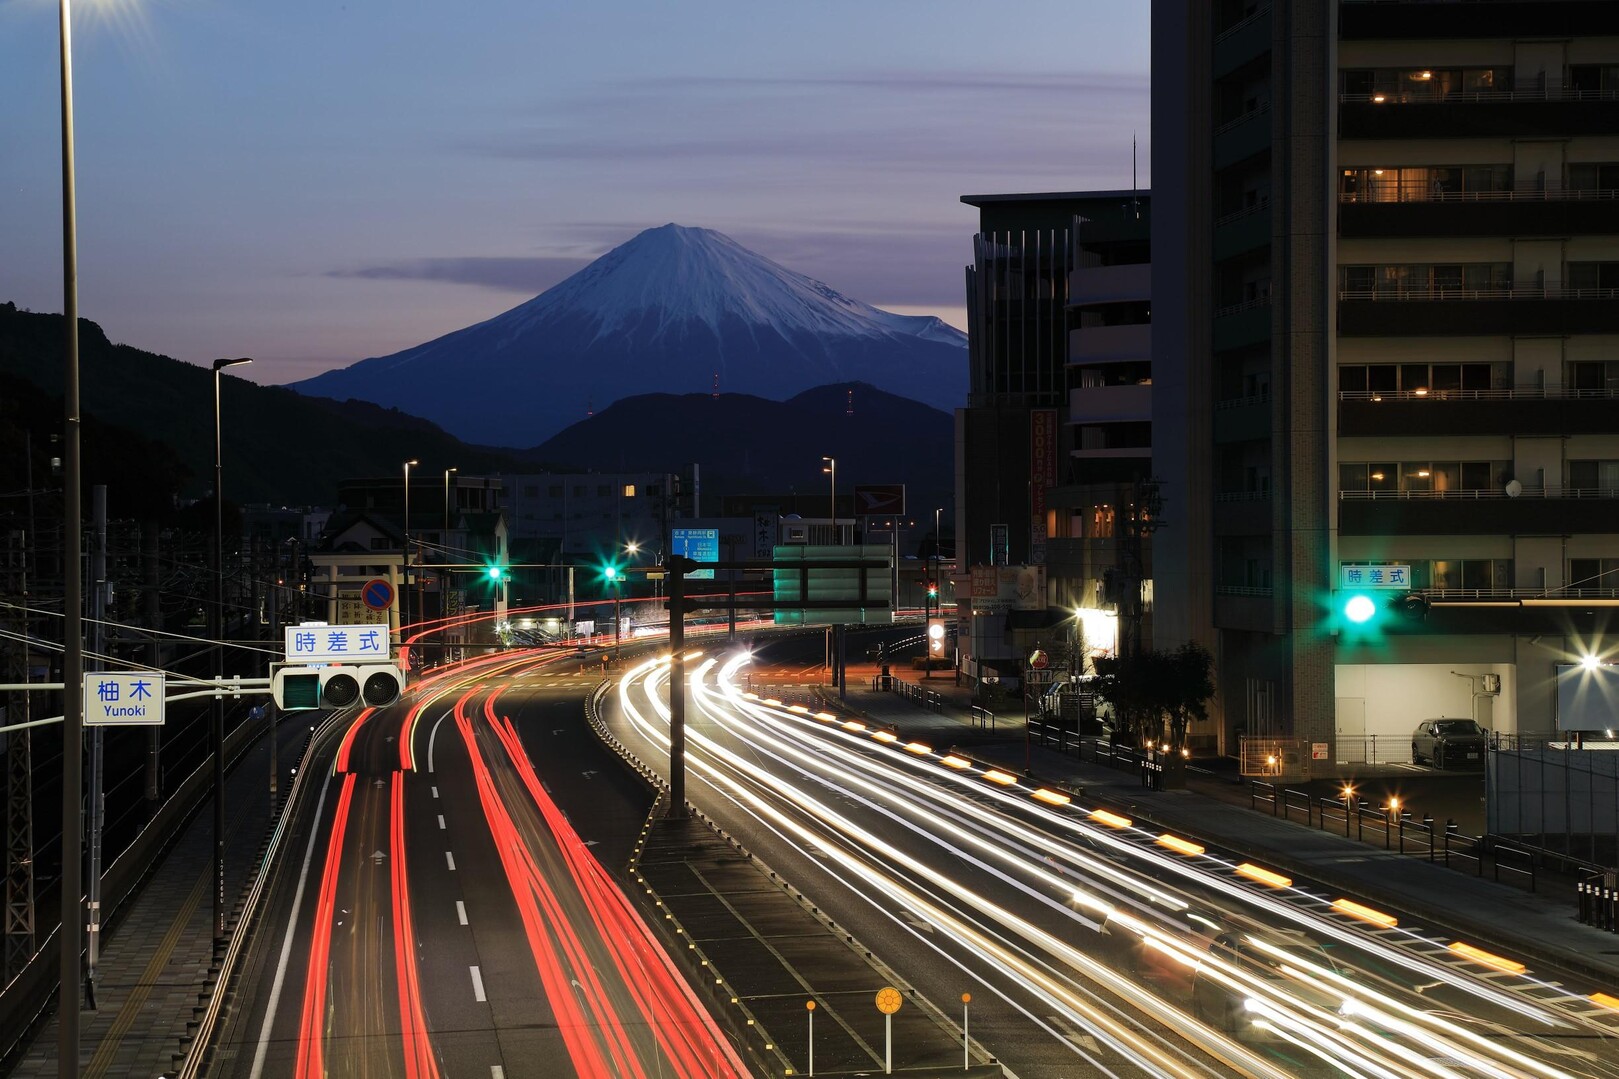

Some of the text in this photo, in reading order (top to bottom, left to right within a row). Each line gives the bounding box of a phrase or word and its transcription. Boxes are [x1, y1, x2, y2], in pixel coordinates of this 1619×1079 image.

[1348, 569, 1404, 584] 時差式
[296, 631, 380, 653] 時差式
[98, 680, 152, 702] 柚木
[104, 705, 146, 717] Yunoki
